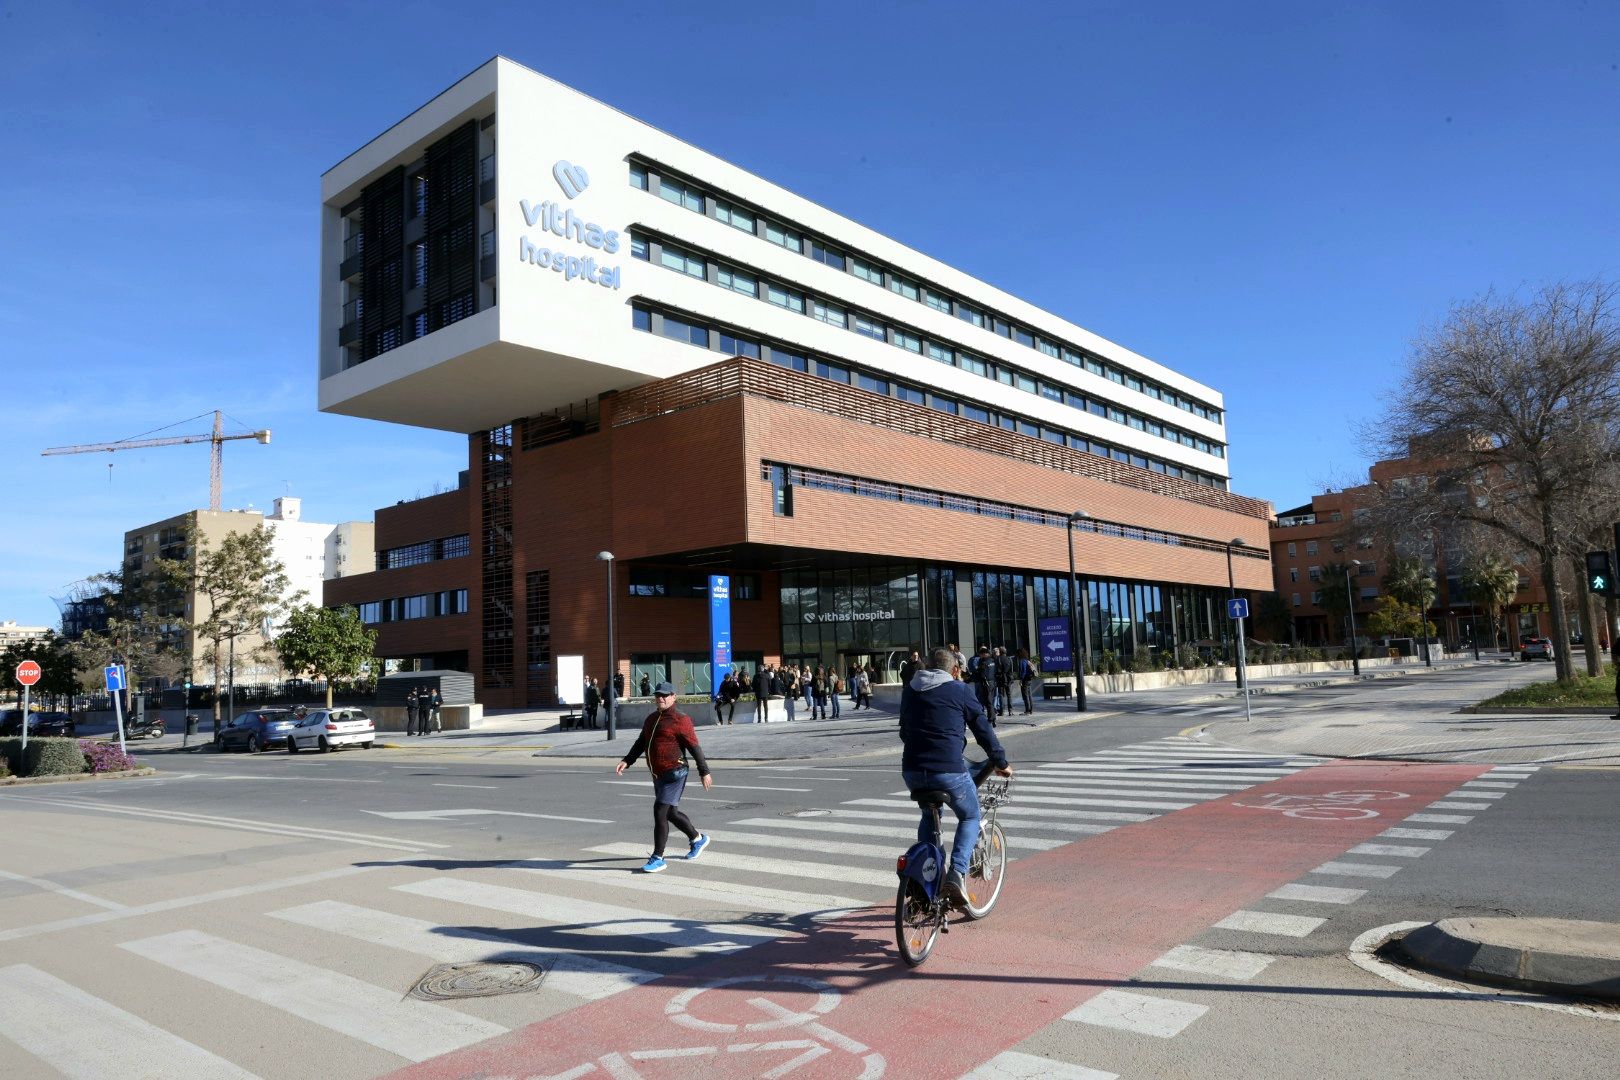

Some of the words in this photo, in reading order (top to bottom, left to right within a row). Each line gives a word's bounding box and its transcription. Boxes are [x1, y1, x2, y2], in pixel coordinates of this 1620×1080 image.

[519, 199, 619, 254] vithas
[519, 235, 620, 290] hospital
[818, 612, 851, 622] vithas
[852, 609, 895, 622] hospital
